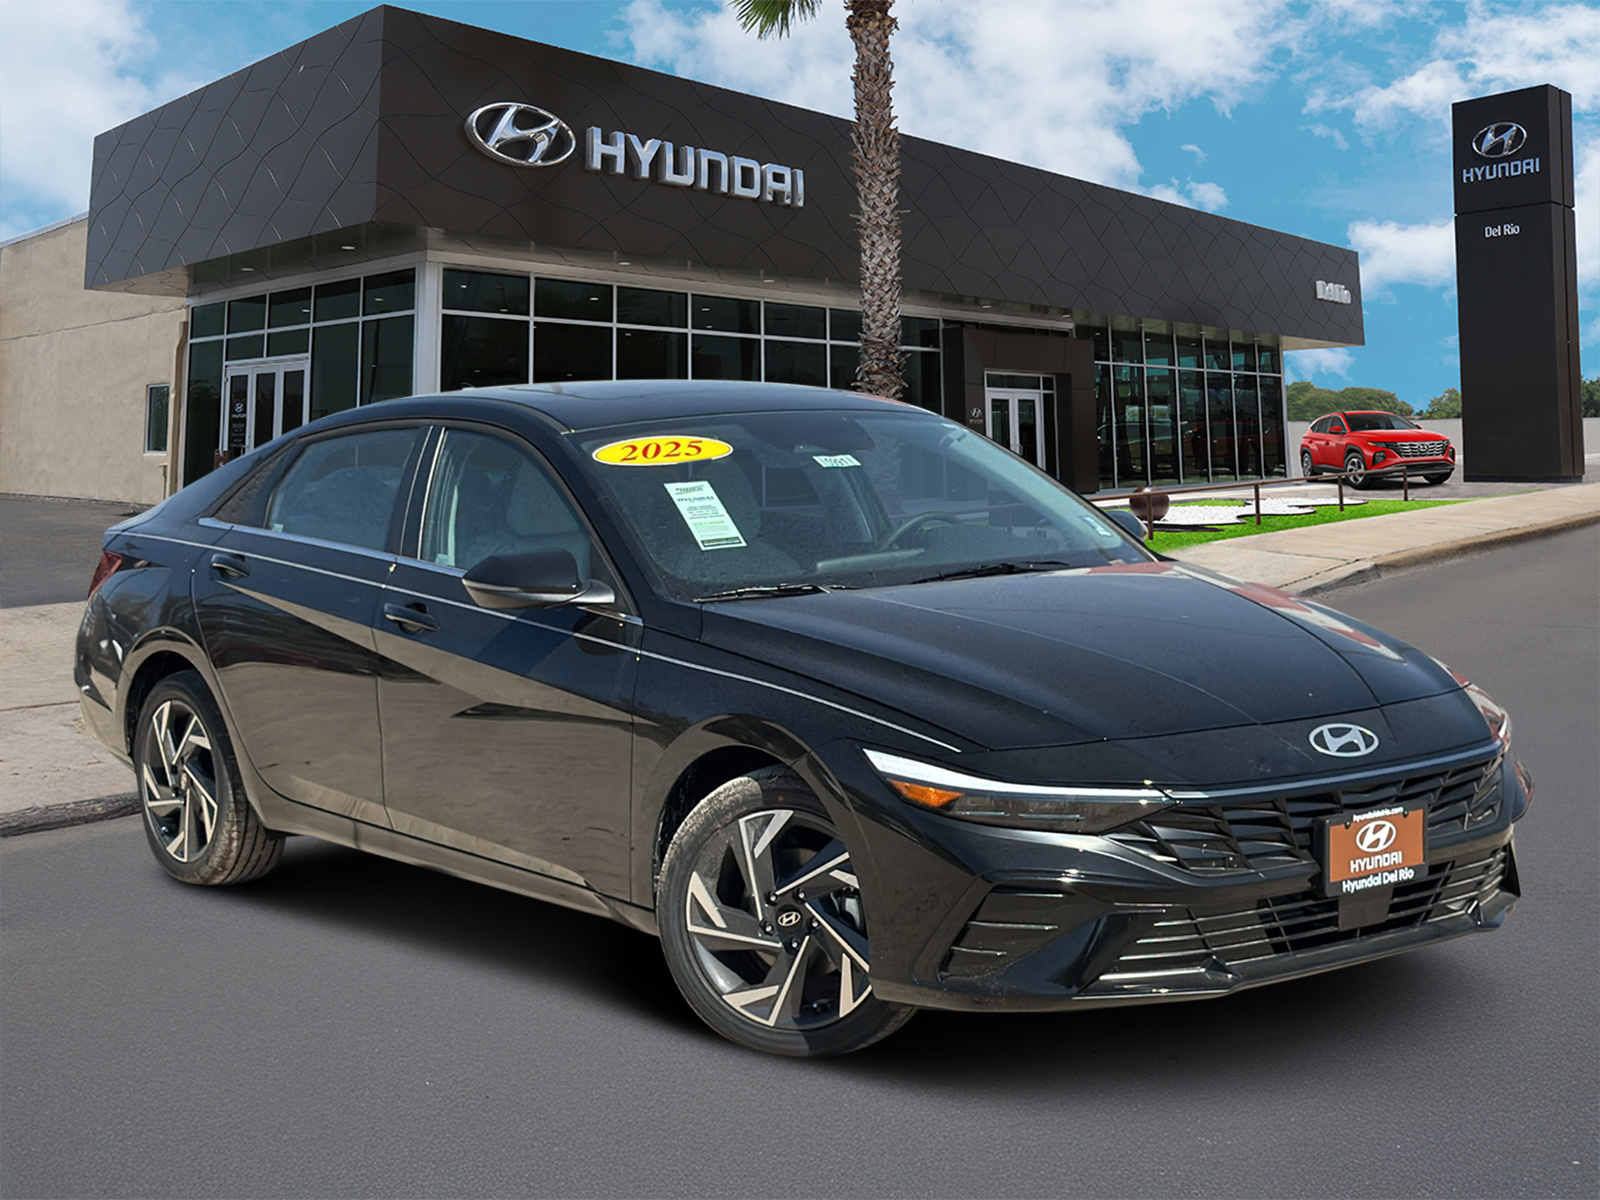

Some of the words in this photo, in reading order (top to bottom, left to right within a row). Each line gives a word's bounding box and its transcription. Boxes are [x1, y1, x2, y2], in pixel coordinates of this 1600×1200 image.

[586, 126, 804, 208] HYUNDAI
[1462, 157, 1540, 183] HYUNDAI
[1485, 225, 1501, 237] Del
[1503, 223, 1520, 236] Rio
[620, 440, 703, 462] 2025
[1350, 850, 1402, 873] HYUNDAI
[1342, 873, 1382, 893] Hyundai
[1383, 870, 1398, 885] Del
[1399, 867, 1415, 881] Rio
